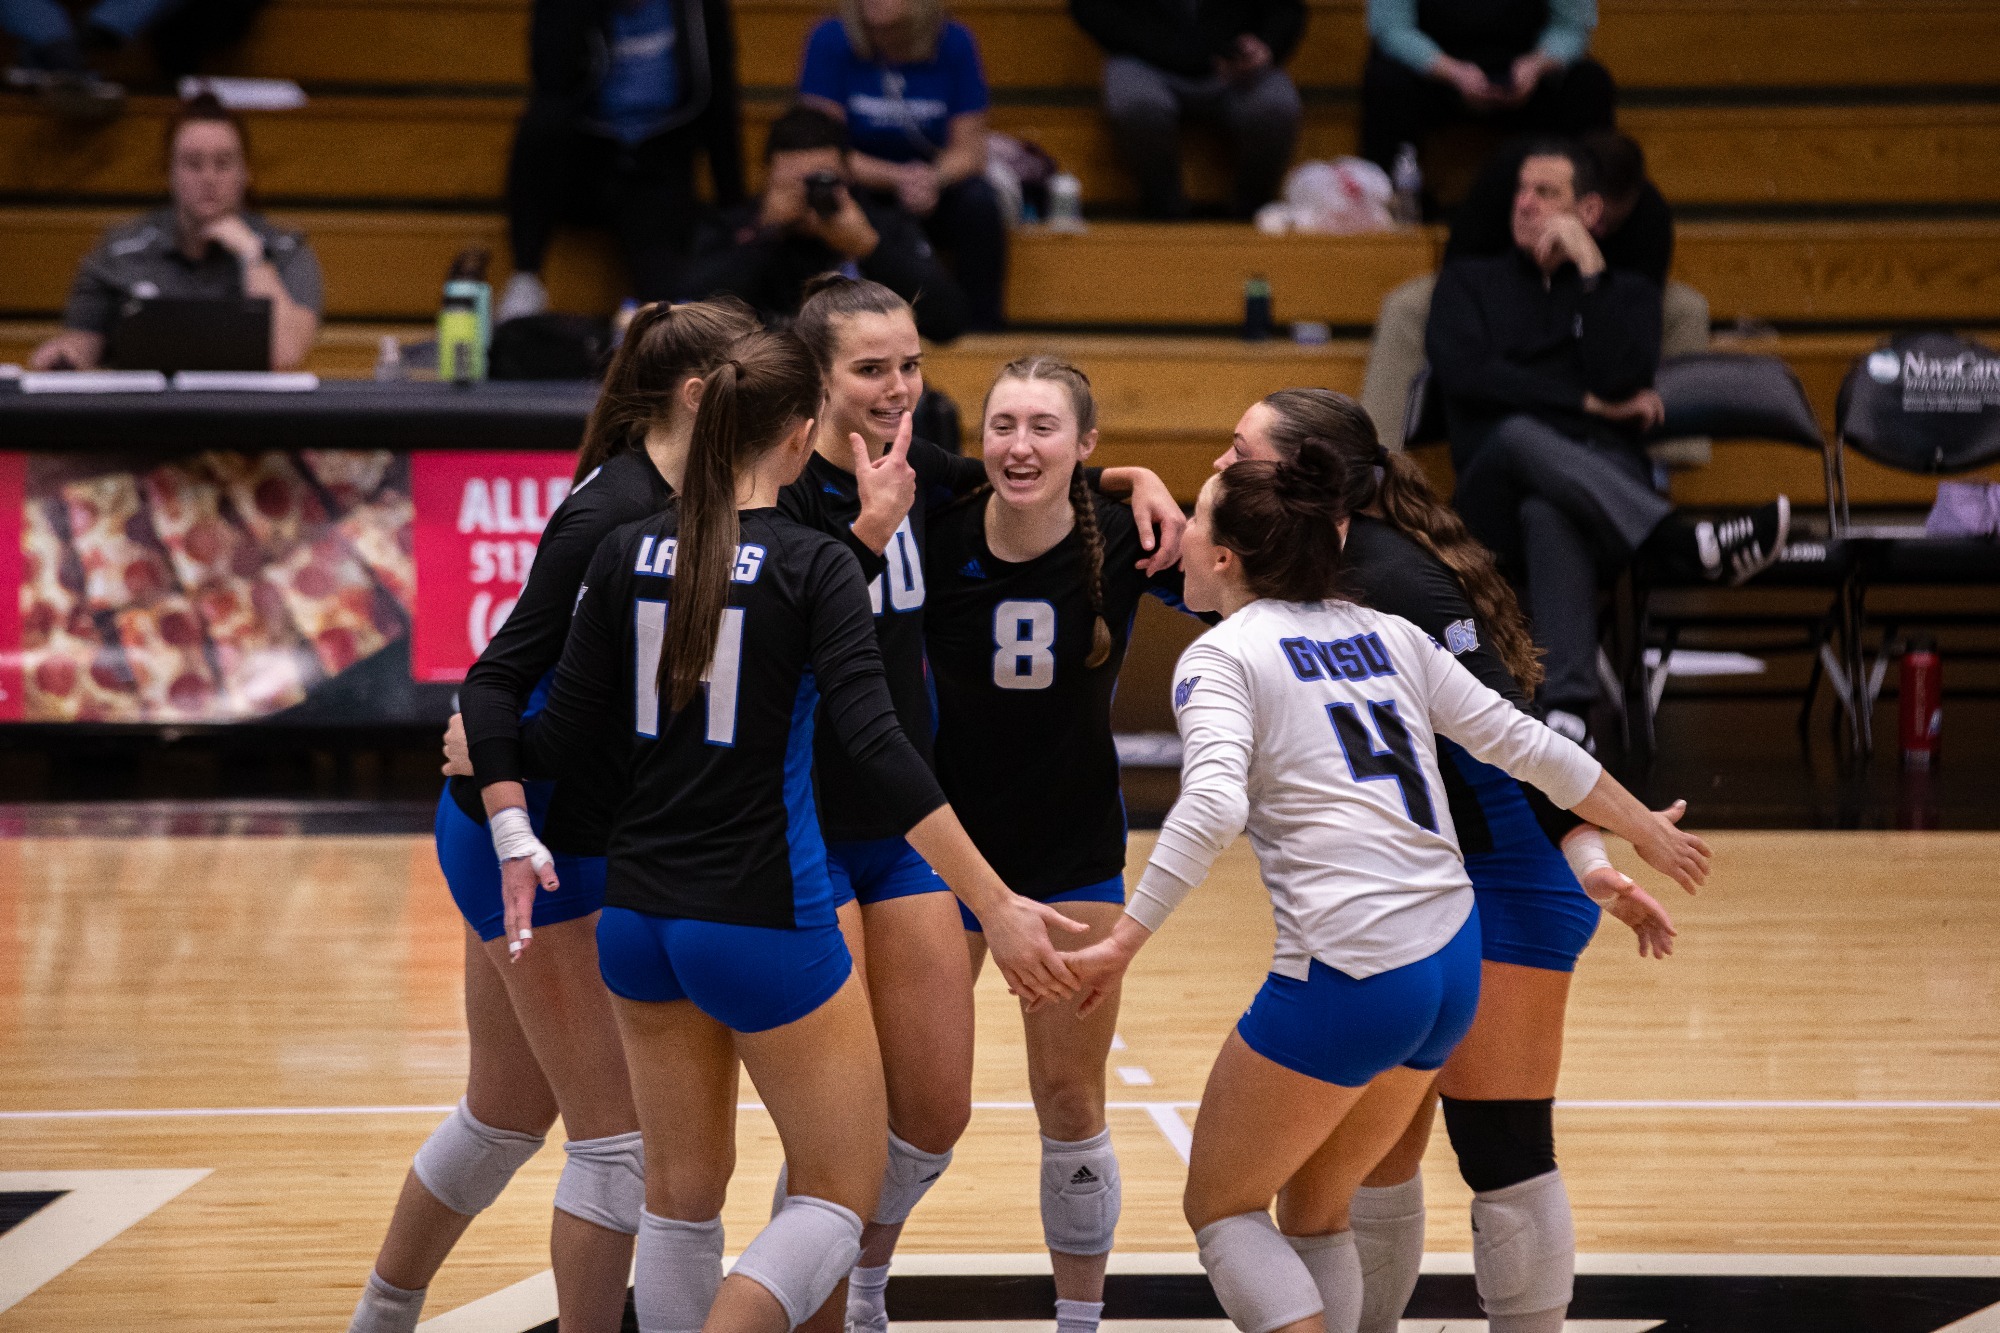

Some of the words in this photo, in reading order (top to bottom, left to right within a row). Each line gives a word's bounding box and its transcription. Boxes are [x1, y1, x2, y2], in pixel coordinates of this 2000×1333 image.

[634, 535, 768, 585] LAS
[992, 598, 1058, 690] 8
[1324, 698, 1441, 834] 4
